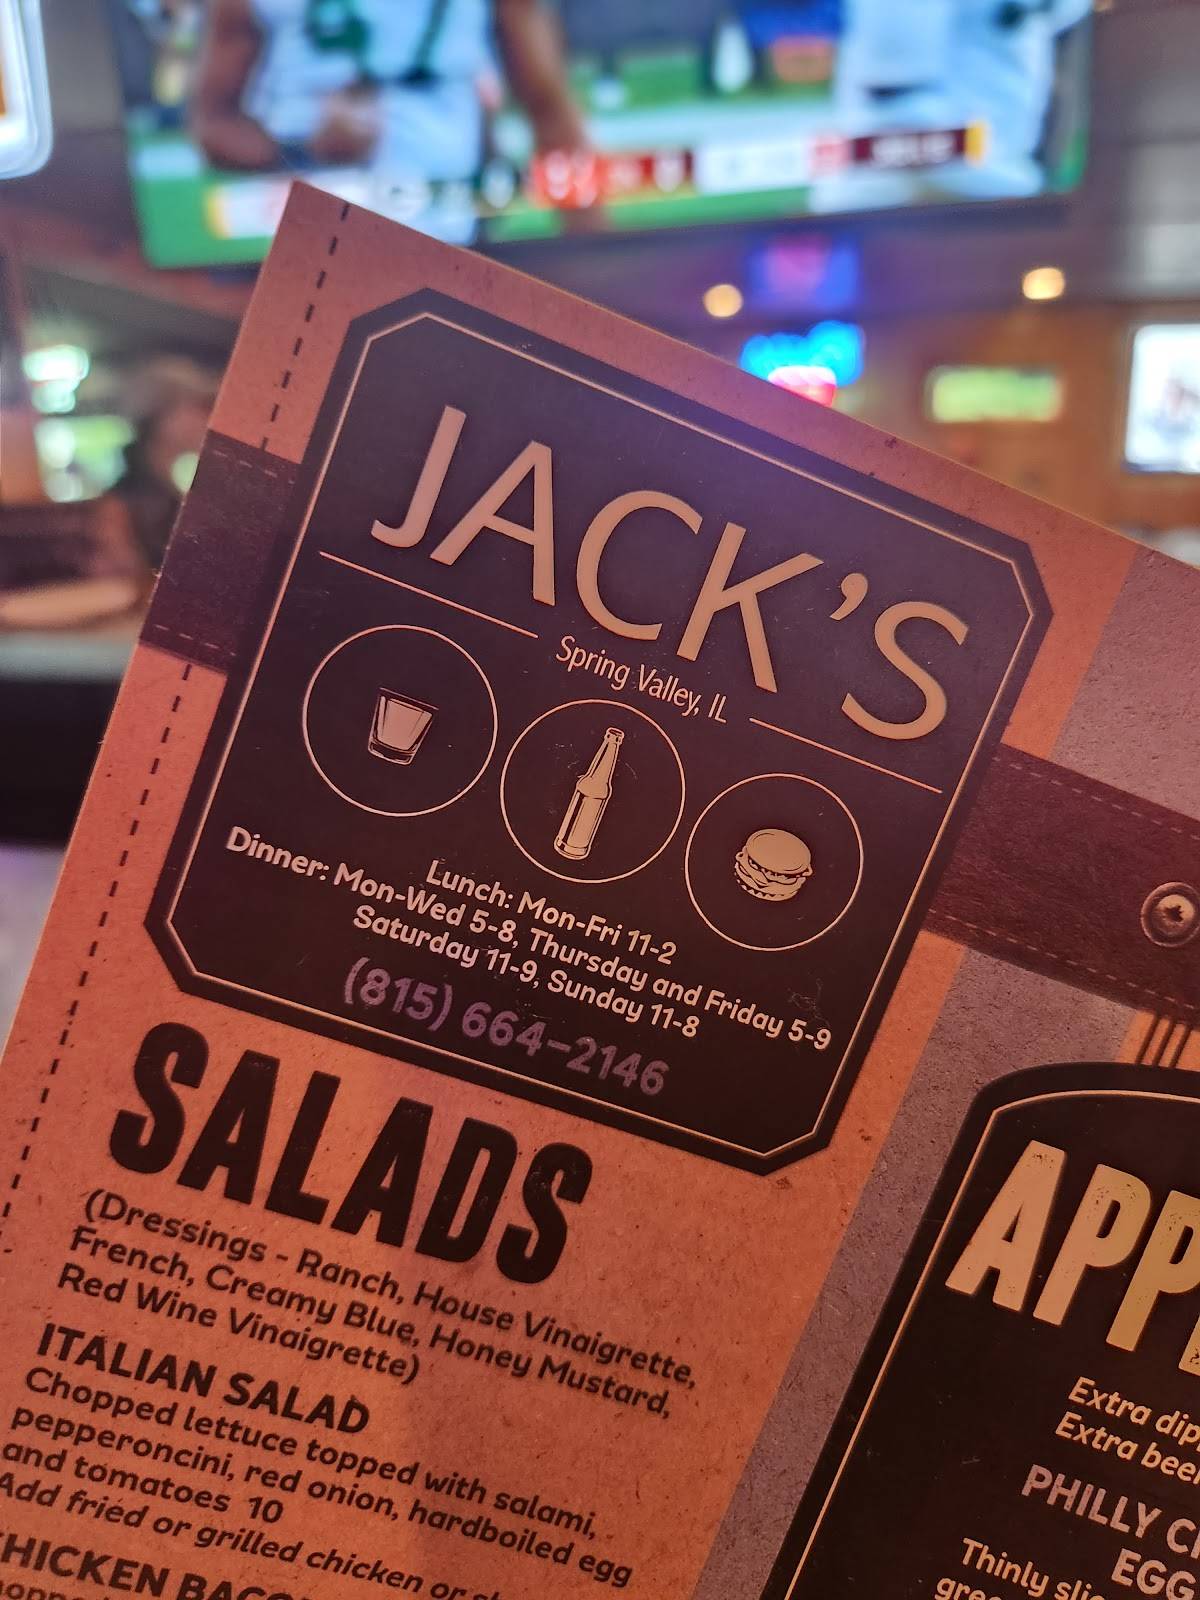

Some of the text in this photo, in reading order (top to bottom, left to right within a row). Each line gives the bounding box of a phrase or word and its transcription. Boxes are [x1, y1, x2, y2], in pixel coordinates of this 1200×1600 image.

[371, 405, 969, 741] JACK'S
[555, 635, 727, 724] Spring Valley, IL
[226, 826, 832, 1051] Dinner: Mon-Wed 5-8, Thursday and Friday 5-9
[353, 904, 701, 1038] Saturday 11-9, Sunday 11-8
[425, 859, 677, 965] Lunch: Mon-Fri 11-2
[344, 956, 671, 1096] (815) 664-2146
[108, 1021, 593, 1284] SALADS
[69, 1225, 671, 1420] French, Creamy Blue, Honey Mustard,
[84, 1188, 268, 1263] (Dressings
[295, 1247, 406, 1304] Ranch,
[412, 1279, 515, 1331] House
[523, 1310, 697, 1390] Vinaigrette,
[944, 1139, 1200, 1377] APP
[36, 1322, 371, 1435] ITALIAN SALAD
[57, 1262, 421, 1386] Red Wine Vinaigrette)
[25, 1367, 597, 1541] Chopped lettuce topped with salami,
[1055, 1411, 1139, 1461] Extra
[1068, 1376, 1200, 1453] Extra dip
[0, 1471, 468, 1600] Add fried or grilled chicken or
[2, 1442, 285, 1525] and tomatoes 10
[11, 1407, 634, 1589] pepperoncini, red onion, hardboiled egg
[1021, 1463, 1200, 1560] PHILLY C
[0, 1532, 171, 1598] HICKEN
[961, 1537, 1050, 1598] Thinly
